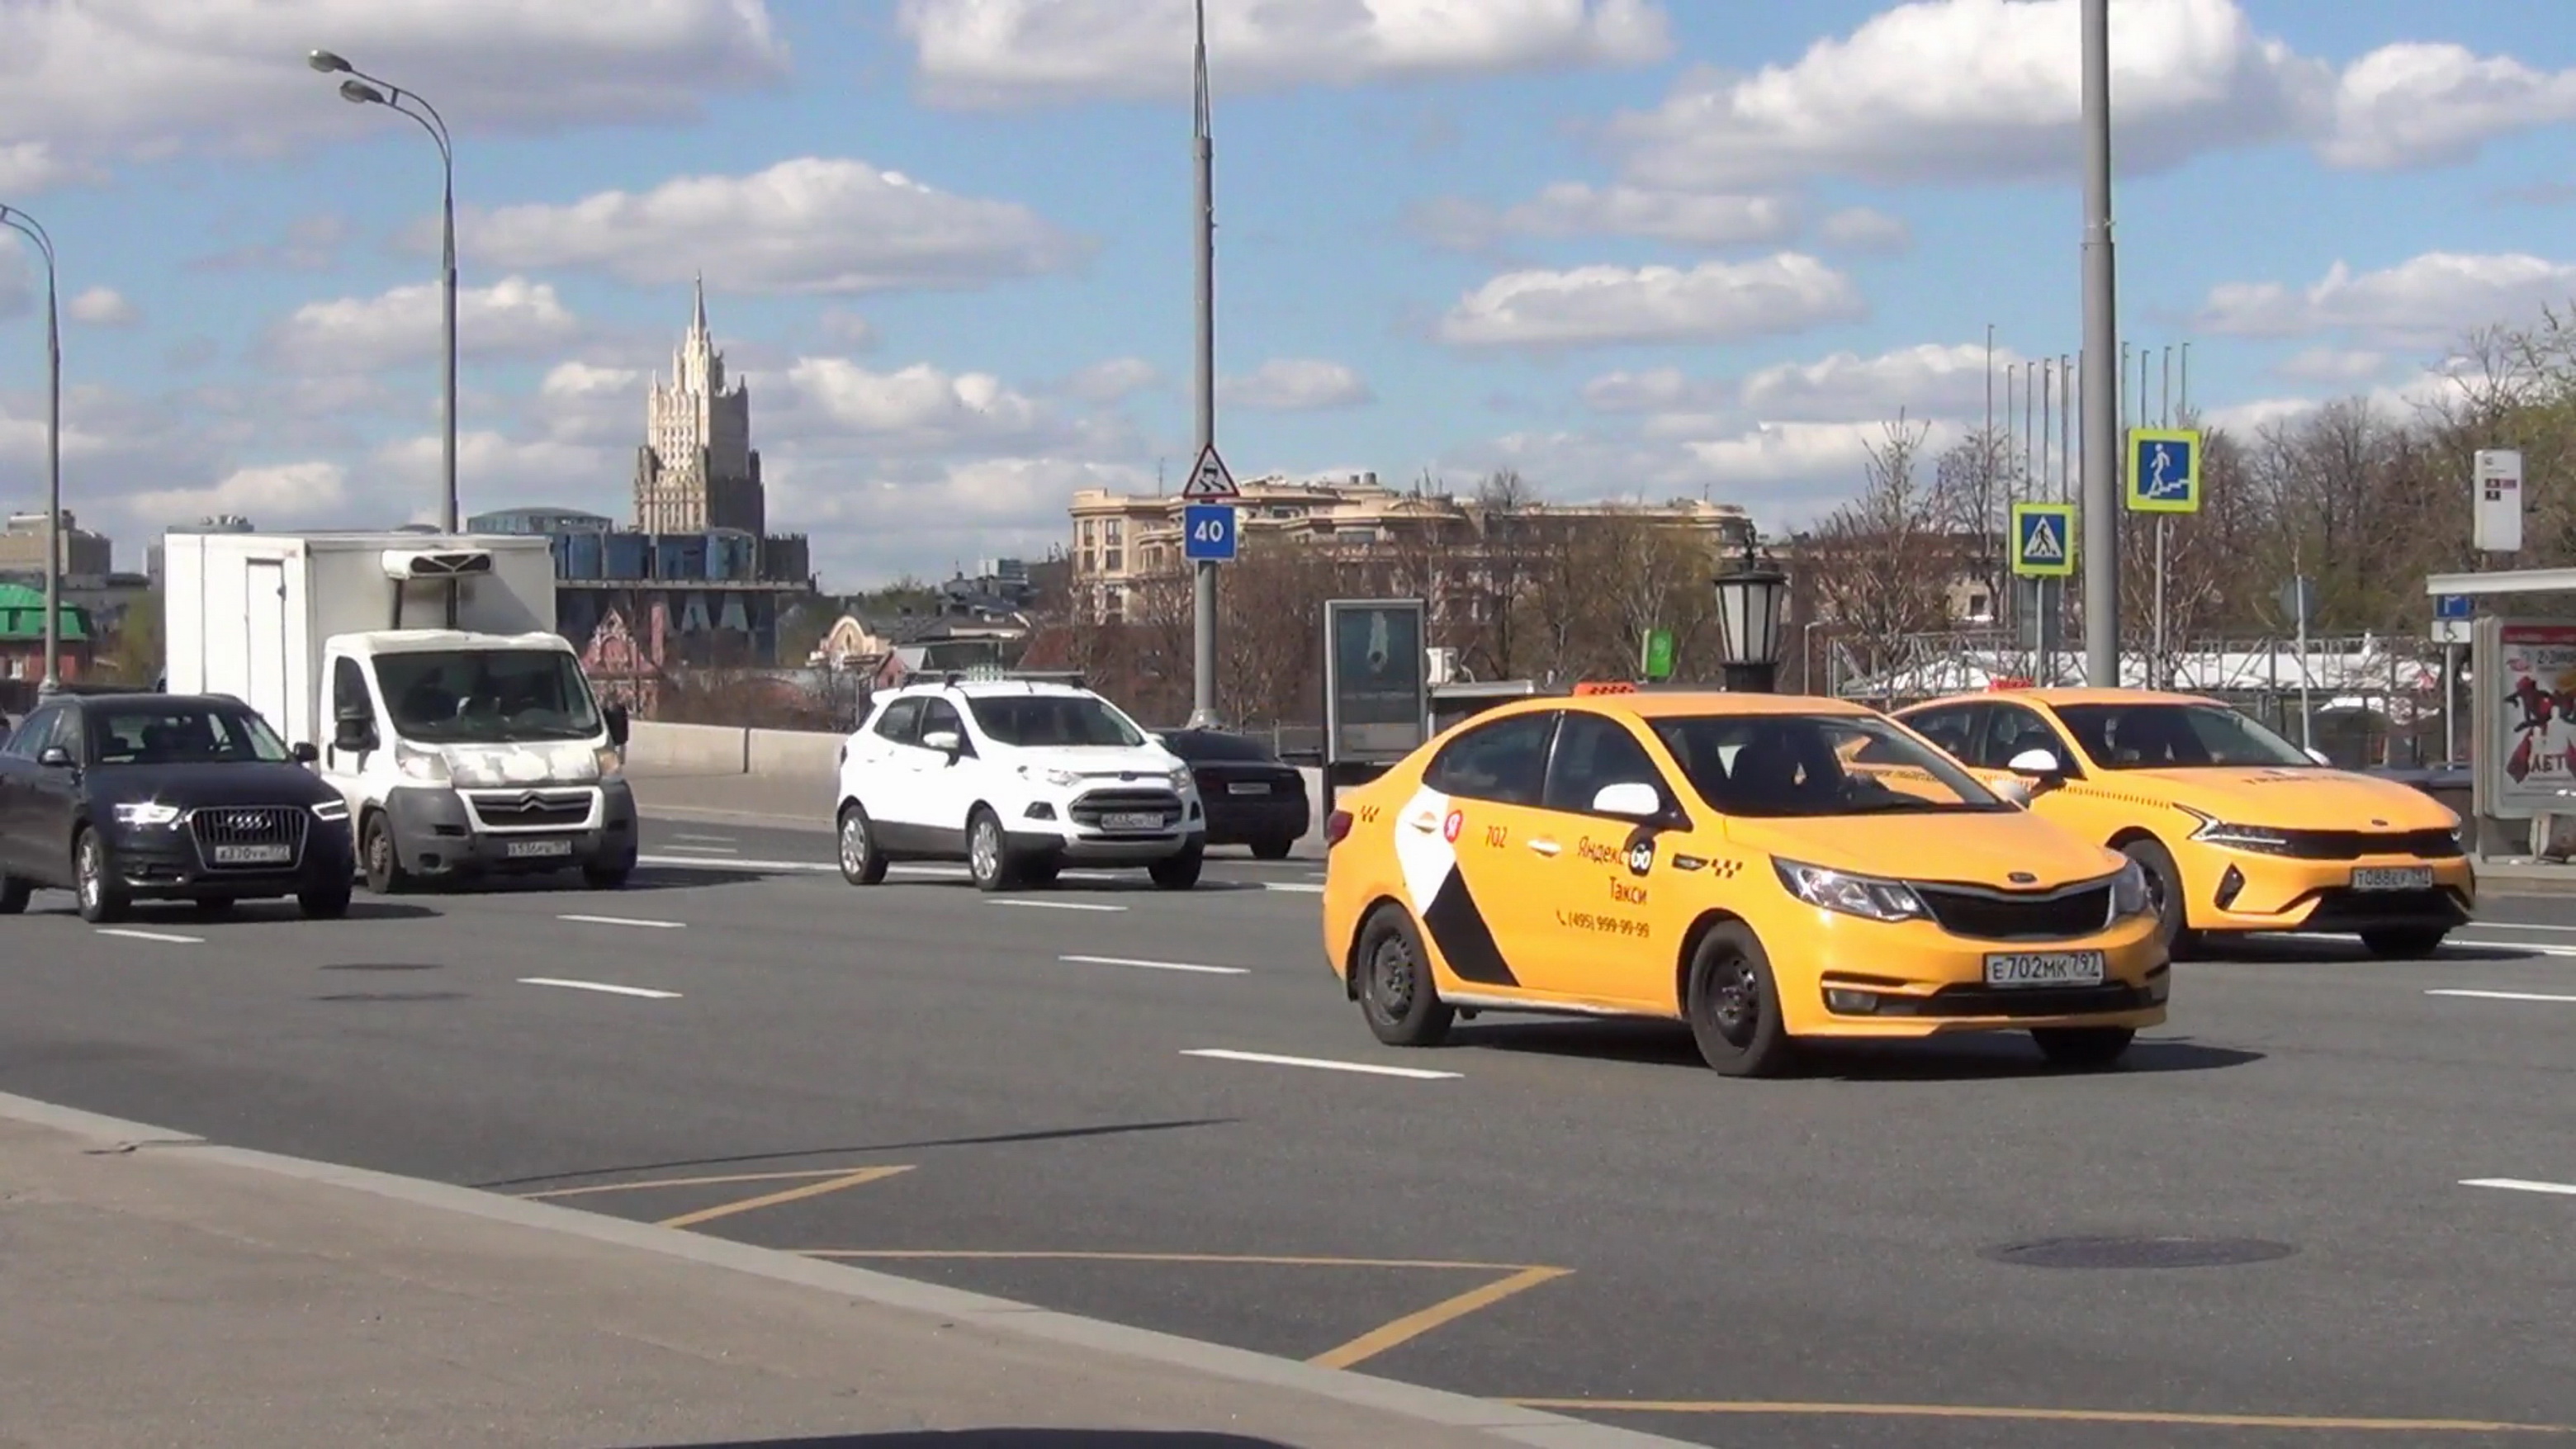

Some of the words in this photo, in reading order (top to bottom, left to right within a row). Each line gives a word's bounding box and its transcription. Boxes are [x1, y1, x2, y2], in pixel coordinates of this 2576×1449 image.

[1194, 519, 1224, 542] 40
[1485, 825, 1508, 849] 702
[1578, 835, 1625, 865] Яндекс
[1609, 875, 1648, 906] Такси
